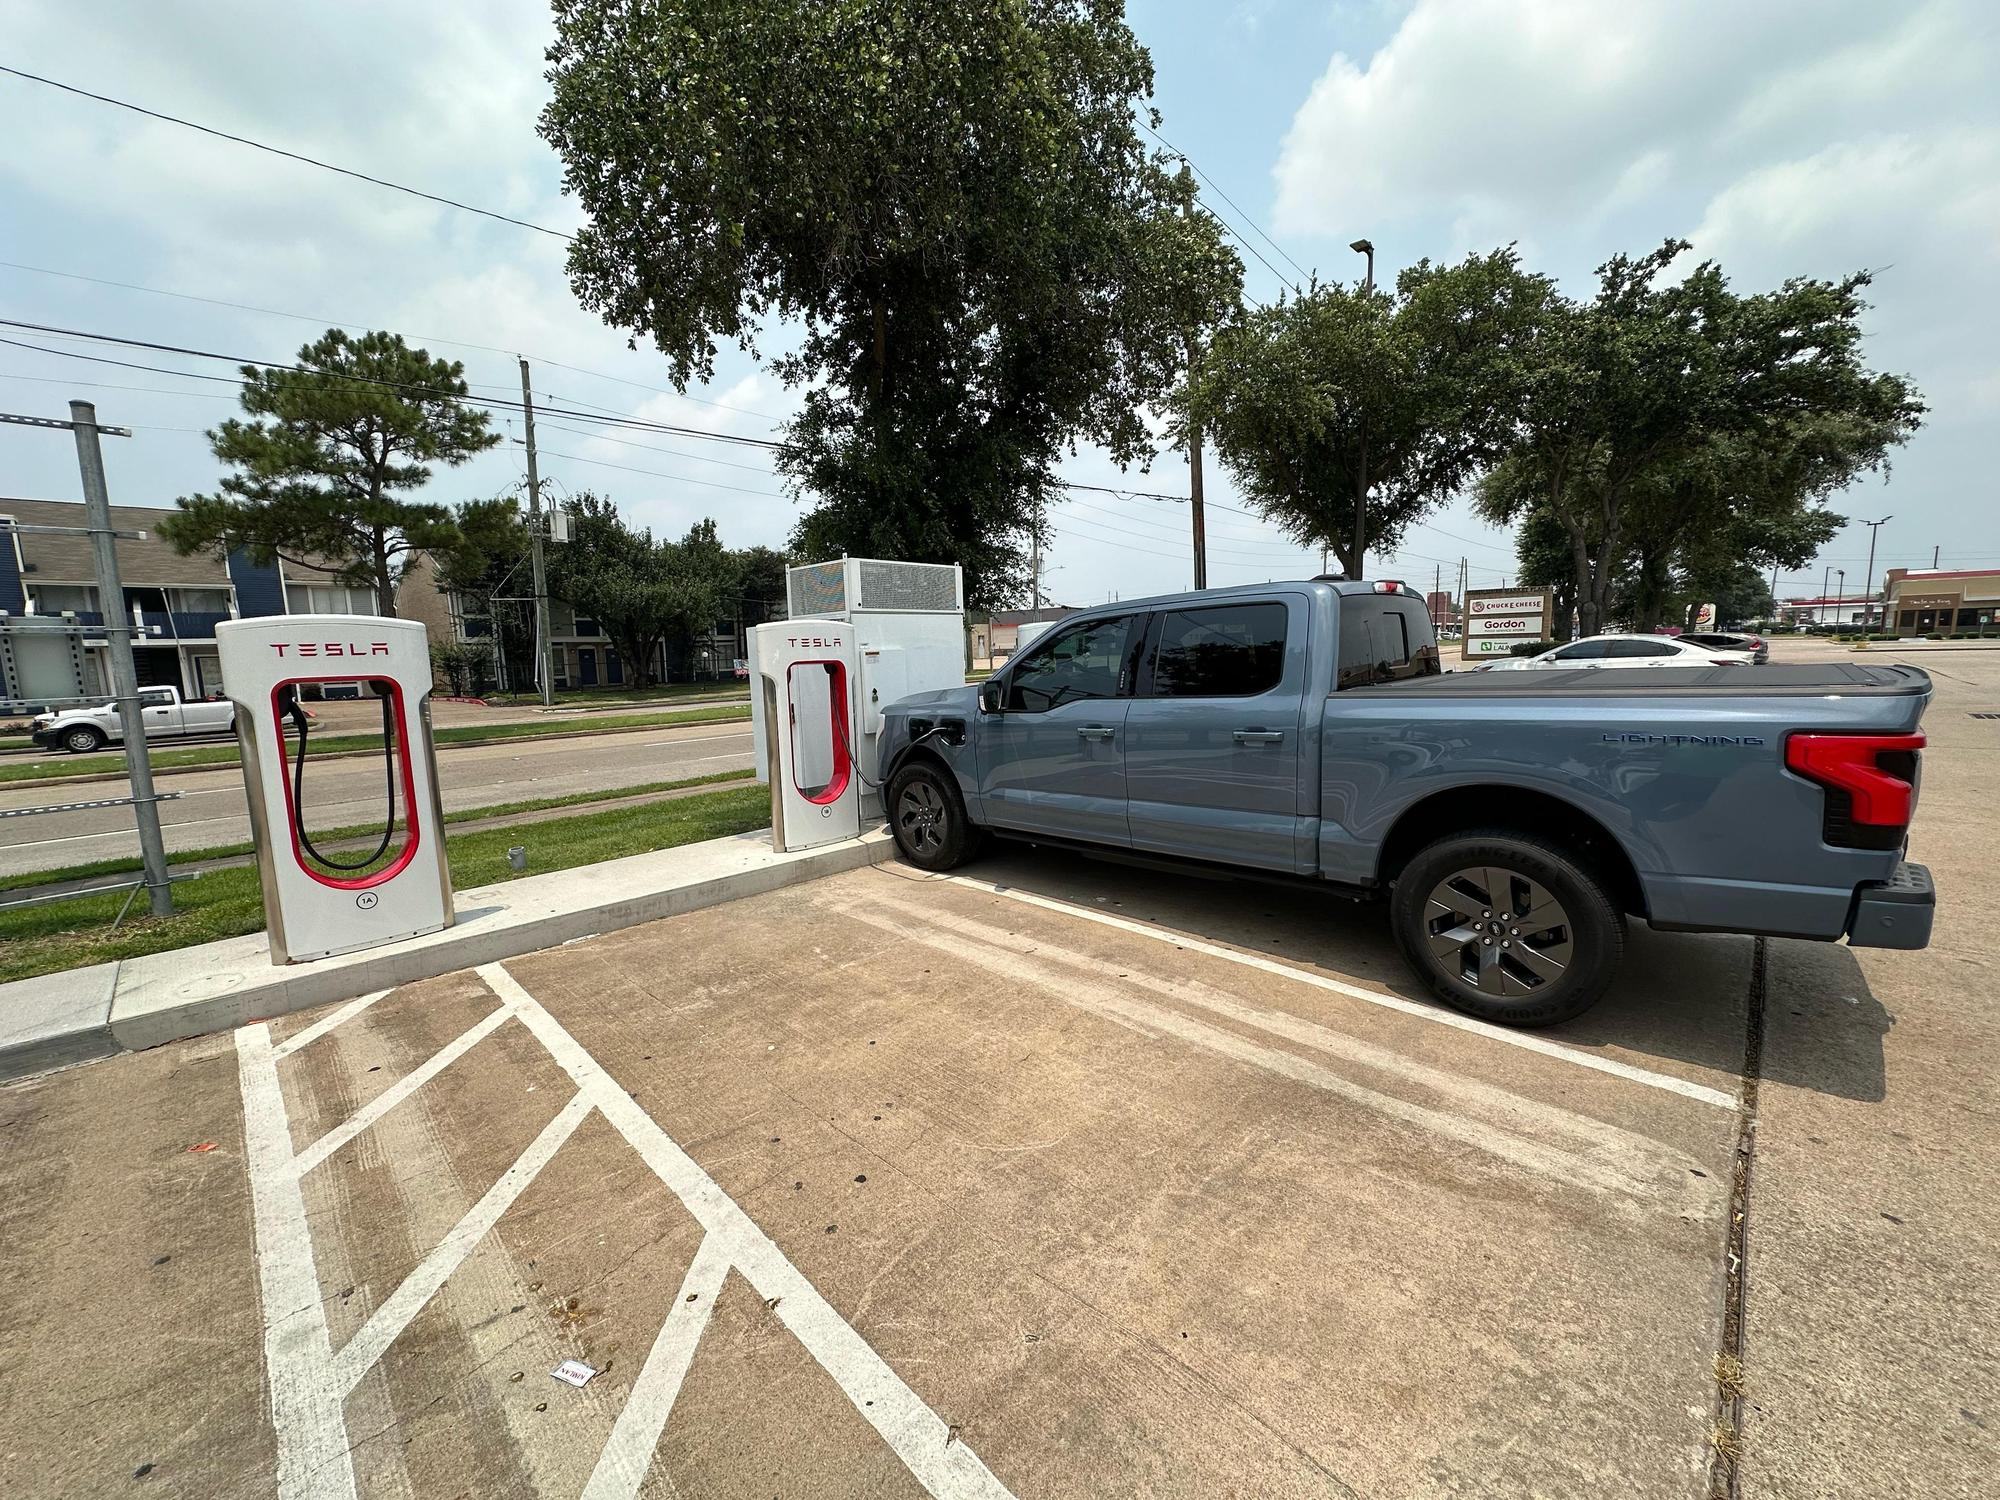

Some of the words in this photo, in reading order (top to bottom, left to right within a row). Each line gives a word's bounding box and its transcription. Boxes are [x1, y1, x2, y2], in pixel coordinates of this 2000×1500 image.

[1484, 620, 1526, 629] Gordon
[787, 638, 841, 647] TESLA
[269, 643, 389, 657] TESLA
[1603, 733, 1765, 746] LIGHTNING
